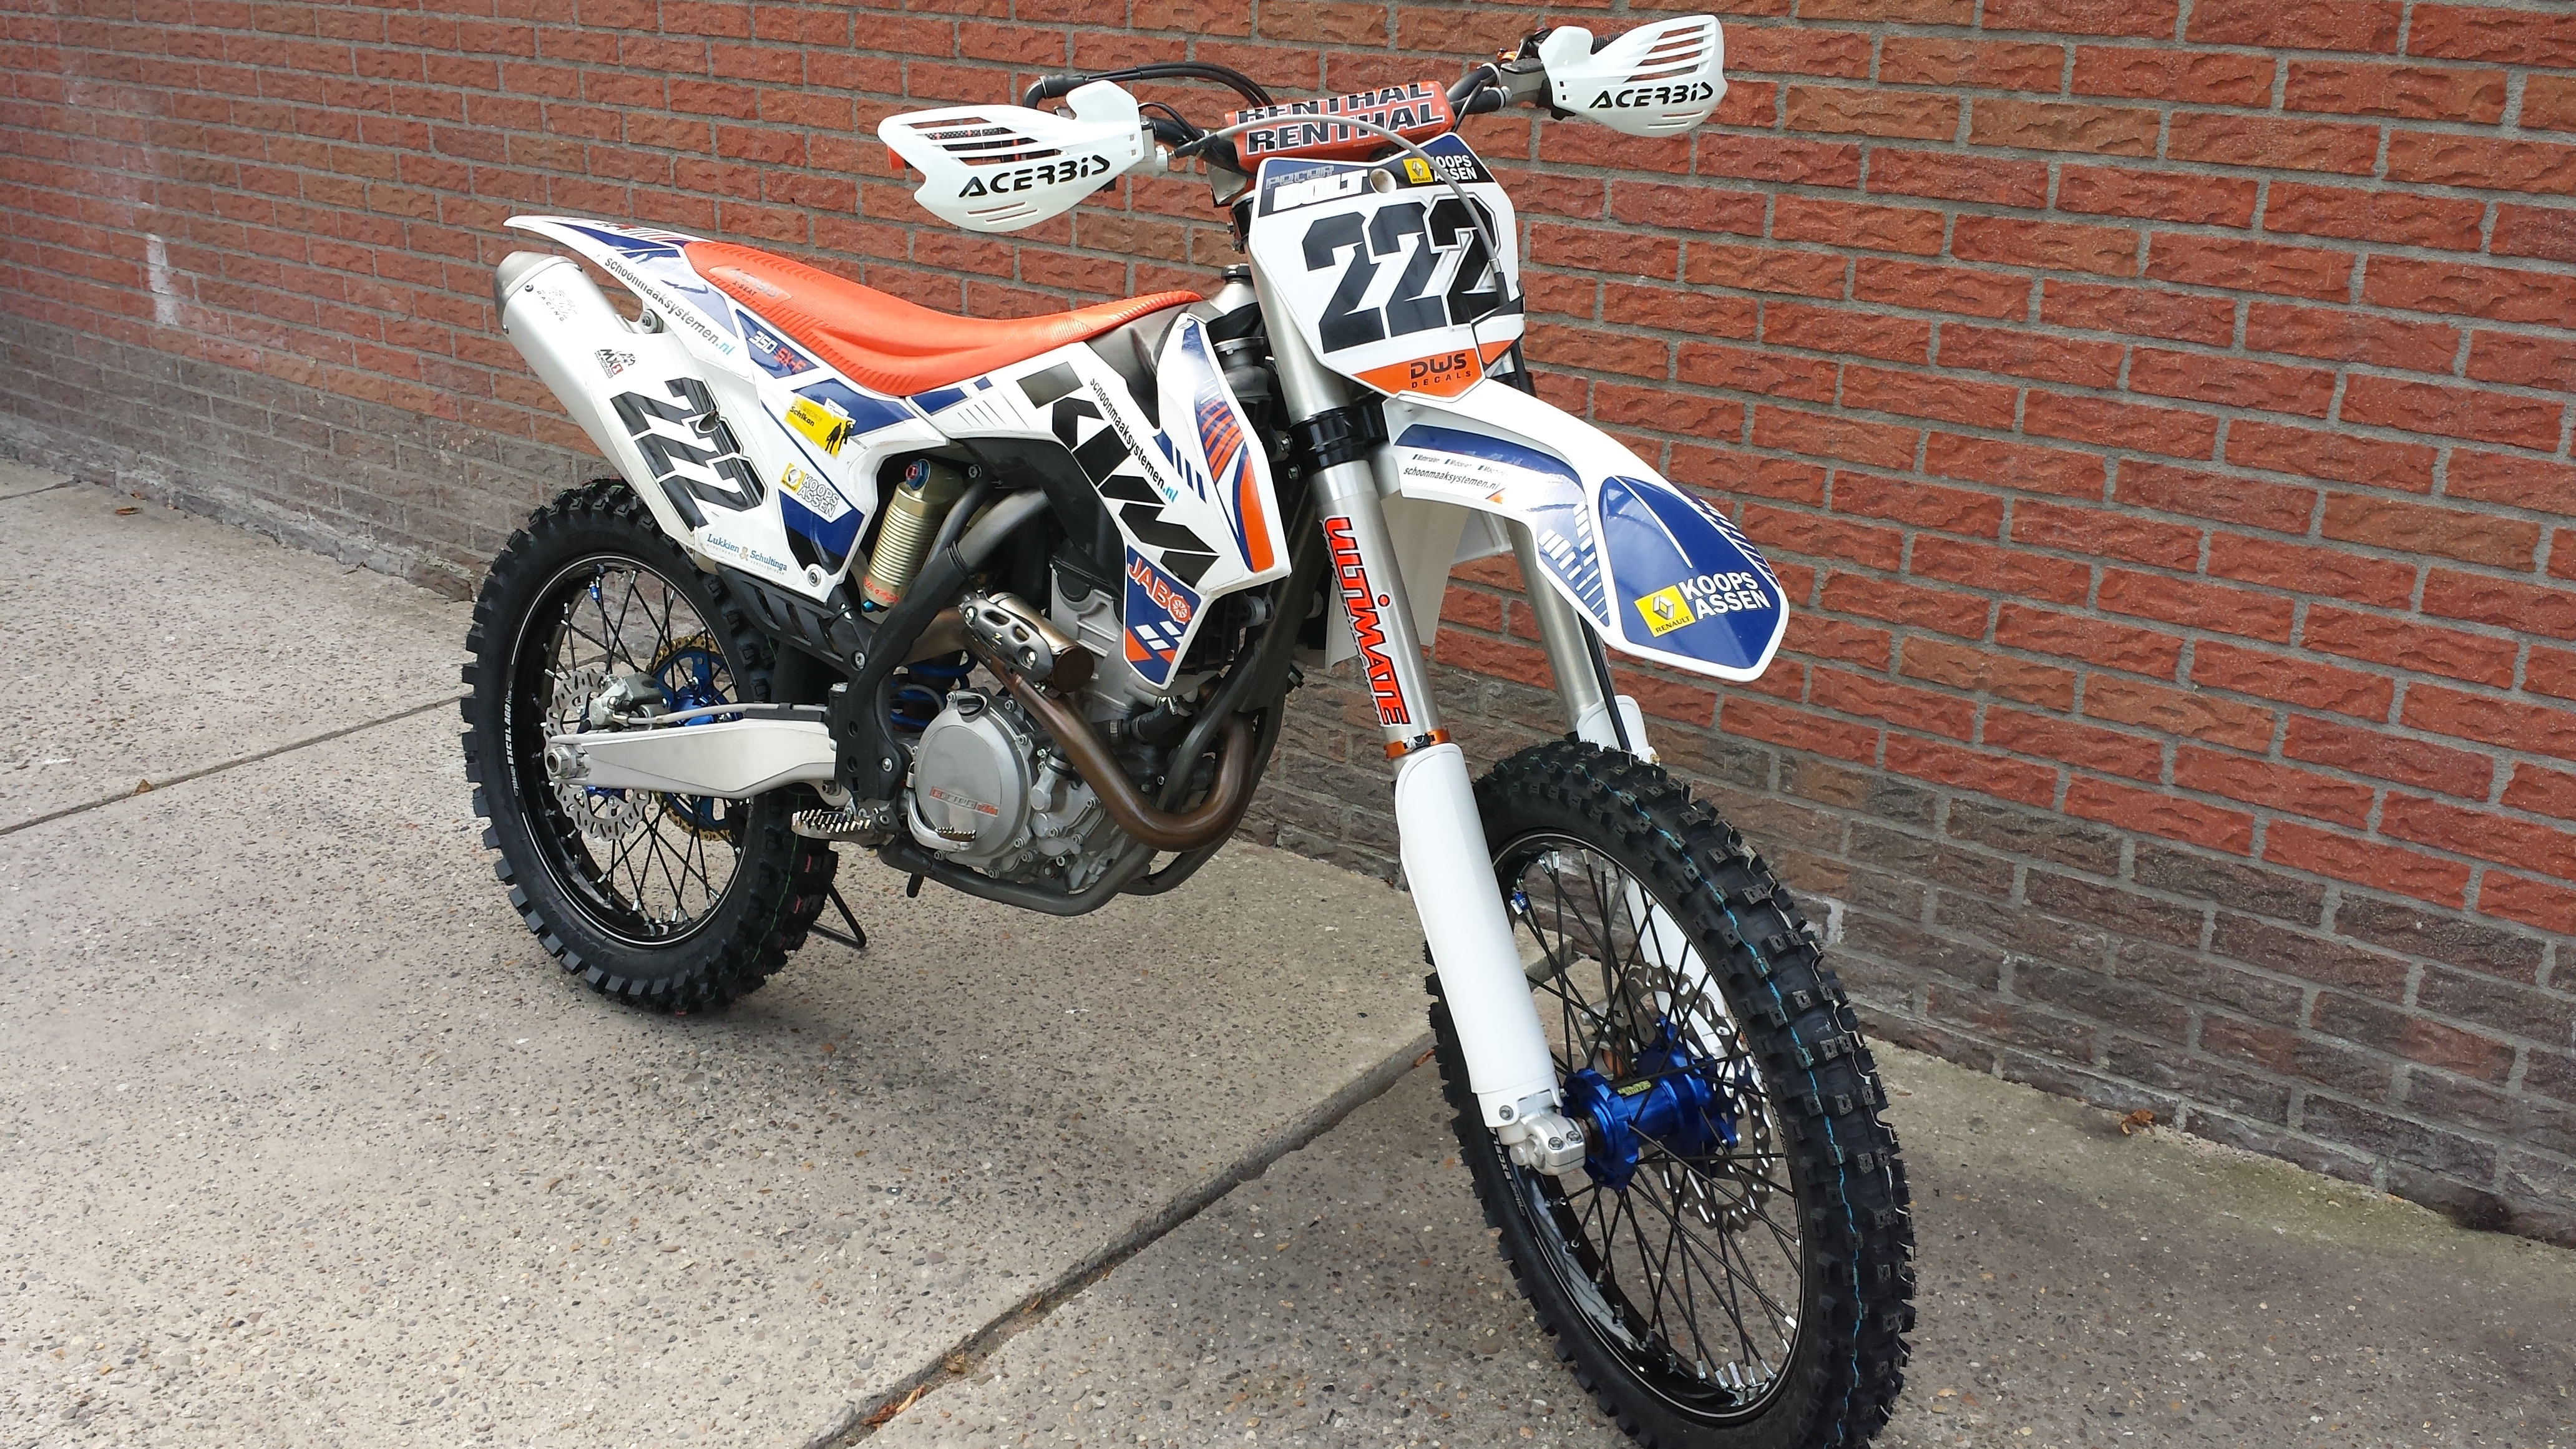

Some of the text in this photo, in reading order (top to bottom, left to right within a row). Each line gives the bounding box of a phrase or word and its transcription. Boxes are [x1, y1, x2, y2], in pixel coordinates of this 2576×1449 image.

[1431, 155, 1472, 168] OOPS
[1302, 198, 1524, 354] 222
[605, 258, 736, 355] schoonmaaksystemen.nl
[748, 330, 778, 354] 350
[1410, 353, 1466, 379] DWS
[1412, 371, 1471, 389] DECALS
[610, 377, 764, 532] 222
[1090, 378, 1178, 503] schoonmaaksystemen.nl
[802, 474, 839, 506] KOOPS
[1403, 467, 1501, 490] schoonmaaksystemen.nl
[797, 486, 836, 517] ASSEN
[707, 534, 739, 553] Lukkien
[749, 550, 788, 571] Schultinga
[1678, 572, 1759, 602] KOOPS
[1695, 590, 1772, 620] ASSEN
[1655, 615, 1690, 633] RENAULT
[505, 727, 514, 765] EXCEL
